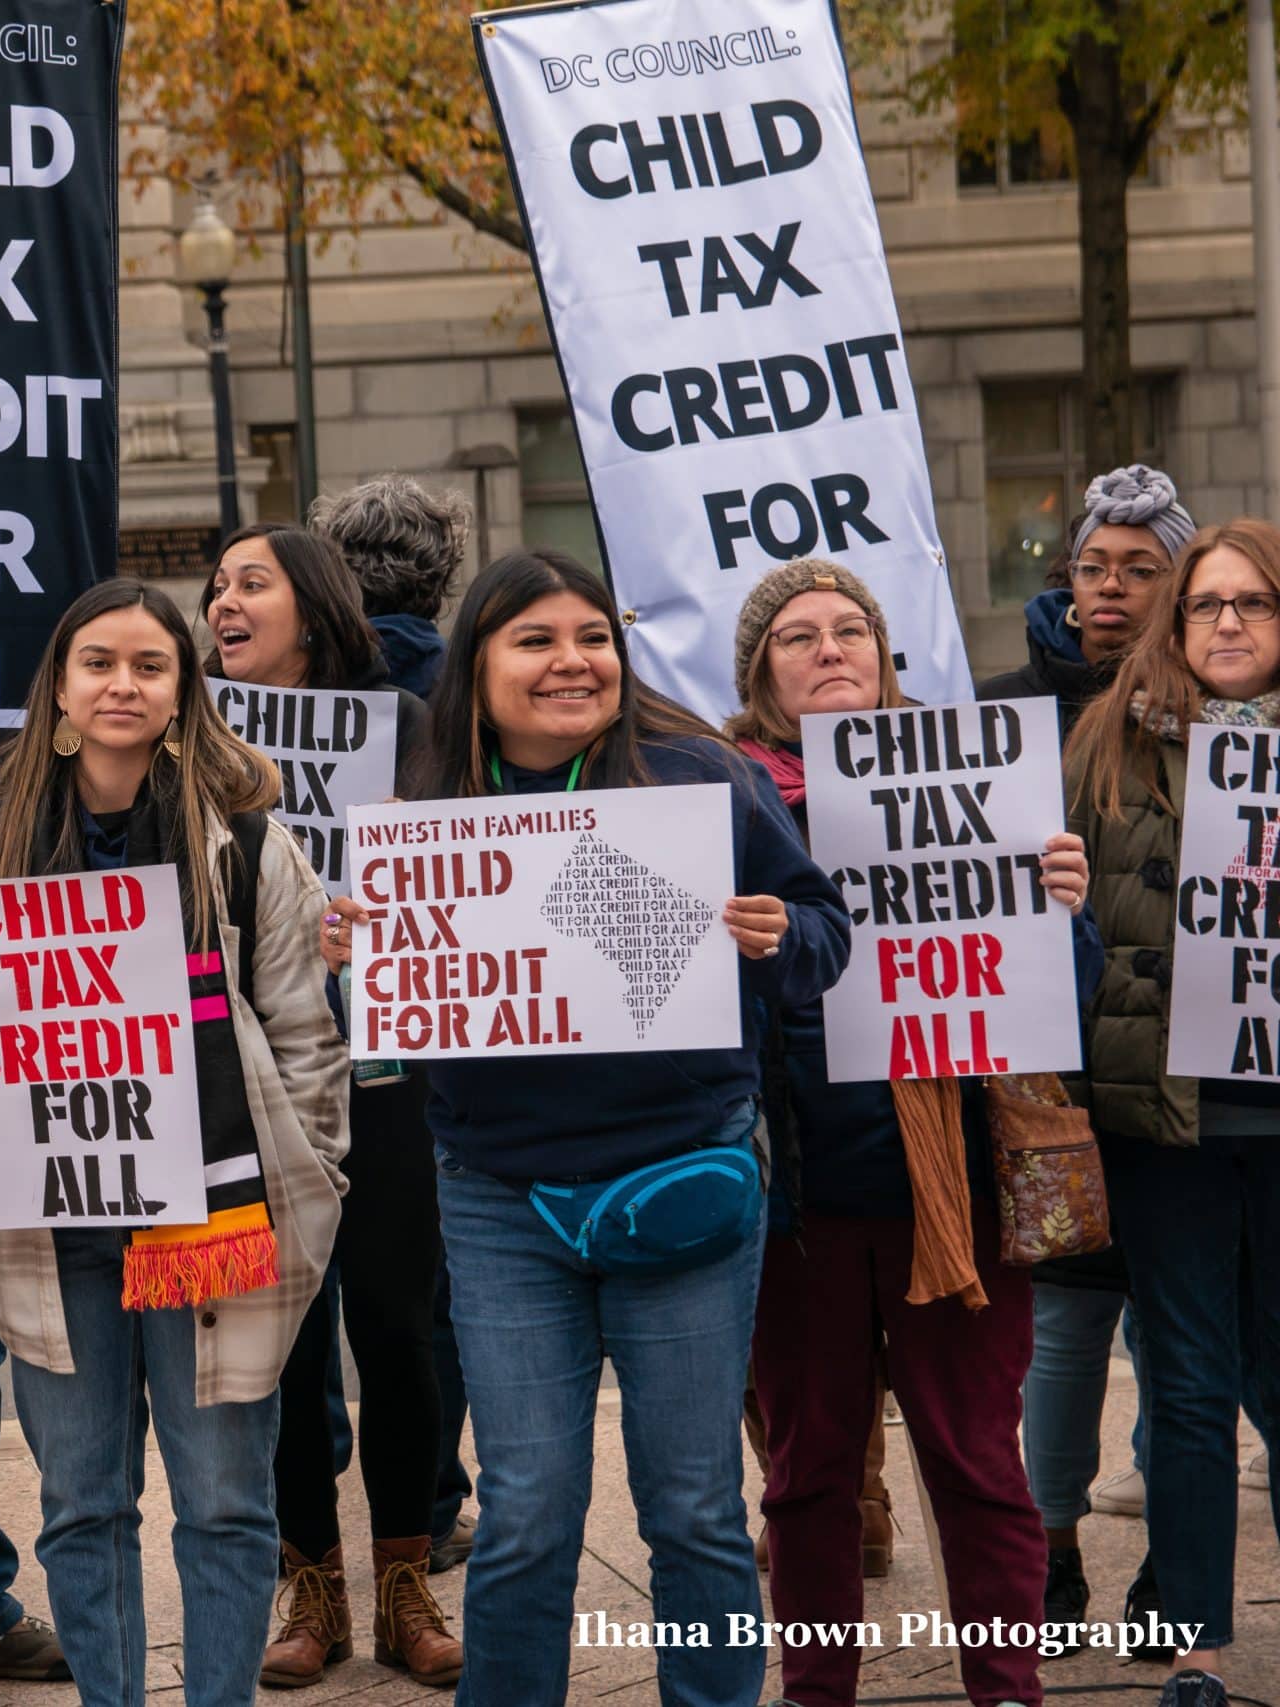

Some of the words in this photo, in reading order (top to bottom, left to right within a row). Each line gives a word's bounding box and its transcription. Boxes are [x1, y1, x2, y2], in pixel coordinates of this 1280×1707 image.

[540, 54, 599, 93] DC
[606, 27, 802, 83] COUNCIL:
[569, 99, 823, 200] CHILD
[637, 221, 822, 318] TAX
[611, 333, 899, 453] CREDIT
[702, 472, 890, 570] FOR
[217, 686, 368, 752] CHILD
[833, 704, 1022, 779] CHILD
[358, 820, 442, 847] INVEST
[451, 817, 476, 841] IN
[485, 808, 596, 837] FAMILIES
[870, 781, 997, 851] TAX
[566, 868, 588, 879] FOR
[592, 867, 612, 877] ALL
[615, 866, 648, 877] CHILD
[575, 856, 595, 866] TAX
[599, 855, 632, 865] CRED
[591, 844, 611, 853] ALL
[361, 850, 513, 904] CHILD
[567, 892, 589, 902] FOR
[593, 891, 613, 901] ALL
[616, 889, 649, 900] CHILD
[653, 888, 674, 898] TAX
[575, 880, 596, 890] TAX
[600, 878, 639, 889] CREDIT
[643, 877, 666, 887] FOR
[831, 852, 1049, 927] CREDIT
[369, 904, 461, 954] TAX
[540, 905, 572, 916] CHILD
[577, 904, 597, 914] TAX
[601, 902, 640, 913] CREDIT
[644, 901, 667, 911] FOR
[671, 900, 691, 910] ALL
[568, 915, 590, 926] FOR
[594, 914, 614, 925] ALL
[617, 913, 650, 924] CHILD
[654, 912, 676, 922] TAX
[679, 910, 717, 921] CREDI
[578, 928, 598, 938] TAX
[601, 925, 642, 937] CREDIT
[645, 924, 668, 935] FOR
[672, 924, 693, 934] ALL
[594, 938, 615, 949] ALL
[617, 937, 652, 948] CHILD
[655, 936, 677, 947] TAX
[618, 961, 653, 972] CHILD
[656, 960, 678, 971] TAX
[646, 948, 669, 959] FOR
[673, 947, 693, 958] ALL
[876, 932, 1006, 1002] FOR
[0, 944, 125, 1012] TAX
[365, 947, 548, 1003] CREDIT
[647, 972, 670, 982] FOR
[367, 1003, 471, 1051] FOR
[486, 996, 583, 1047] ALL
[889, 1010, 1008, 1079] ALL
[30, 1078, 154, 1145] FOR
[41, 1154, 167, 1218] ALL
